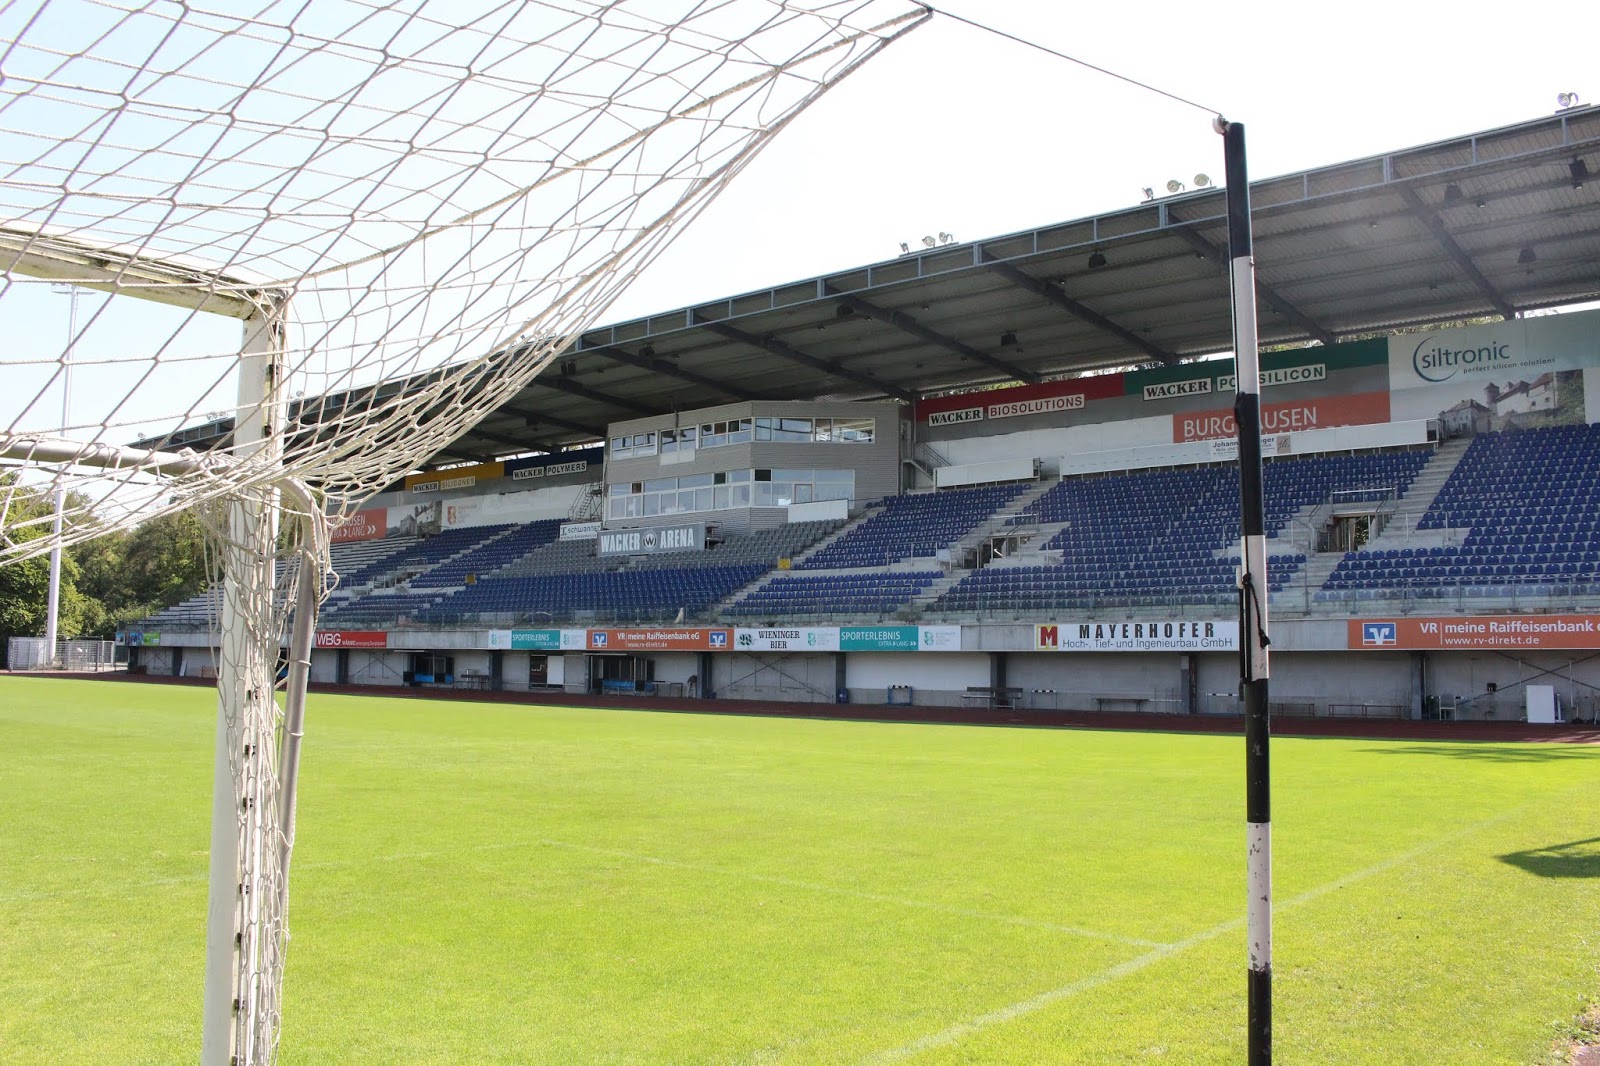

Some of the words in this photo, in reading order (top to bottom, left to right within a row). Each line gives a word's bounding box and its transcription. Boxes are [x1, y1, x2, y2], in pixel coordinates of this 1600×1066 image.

[1421, 341, 1509, 369] siltronic
[1463, 364, 1490, 374] perfect
[1492, 362, 1517, 371] silicon
[1520, 357, 1556, 367] solutions
[1145, 381, 1209, 398] WACKER
[1219, 365, 1323, 389] POSILICON
[930, 409, 982, 425] WACKER
[990, 396, 1083, 417] BIOSOLUTIONS
[1183, 406, 1317, 437] BURGUSEN
[514, 468, 543, 480] WACKER
[547, 463, 586, 475] POLYMERS
[413, 482, 438, 493] WACKER
[441, 478, 475, 489] SILICONES
[600, 533, 641, 553] WACKER
[660, 528, 695, 549] ARENA
[758, 630, 800, 639] WIENINGER
[1079, 622, 1214, 639] MAYERHOFER
[1420, 622, 1438, 634] VR
[1444, 622, 1486, 634] meine
[1489, 620, 1594, 634] Raiffeisenbank
[317, 633, 342, 646] WBG
[617, 632, 625, 640] VR
[627, 632, 645, 640] meine
[646, 632, 691, 640] Raiffeisenbank
[690, 632, 700, 640] eG
[841, 631, 901, 641] SPORTERLEBNIS
[1062, 639, 1092, 649] Hoch-,
[1095, 638, 1114, 648] Tief-
[1116, 638, 1133, 648] und
[1136, 638, 1198, 650] Ingenieurbau
[1200, 637, 1233, 648] GmbH
[1444, 635, 1540, 646] www.rv-direkt.de
[770, 640, 788, 649] BIER
